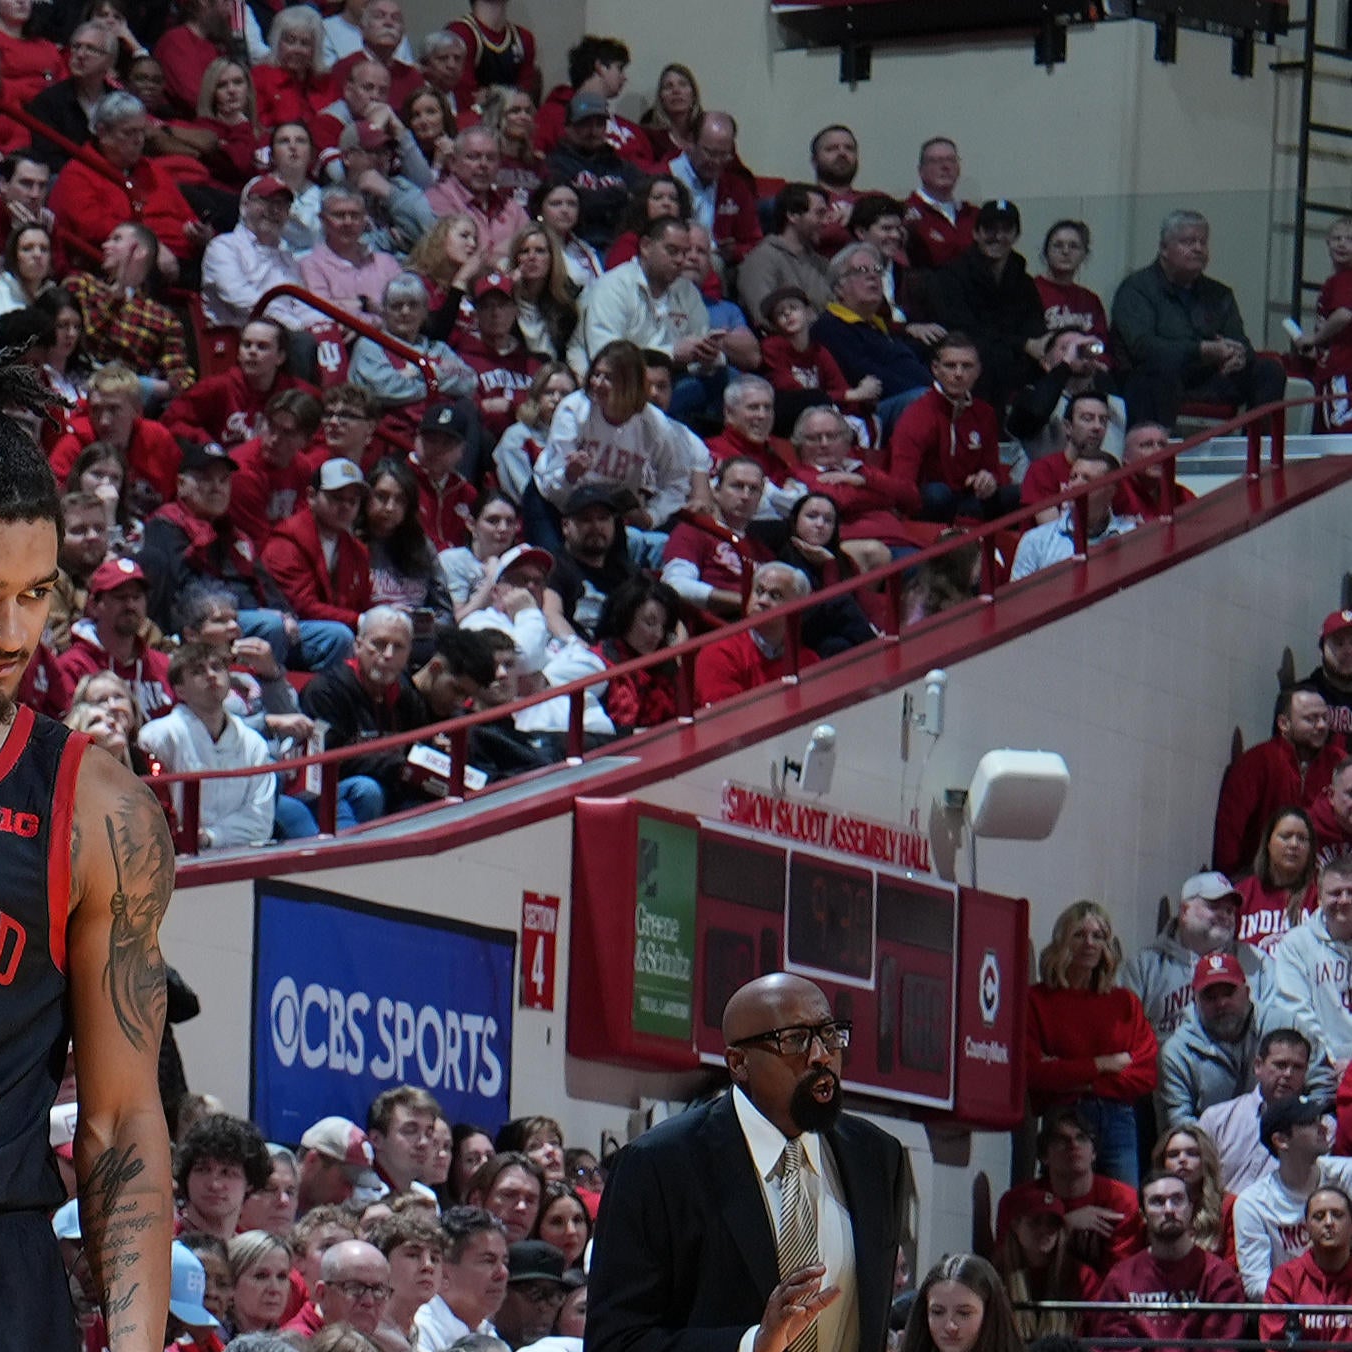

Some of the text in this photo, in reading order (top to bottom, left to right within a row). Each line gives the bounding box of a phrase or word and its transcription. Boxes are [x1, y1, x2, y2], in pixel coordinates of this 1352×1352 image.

[531, 935, 545, 996] 4
[300, 983, 502, 1097] CBS SPORTS
